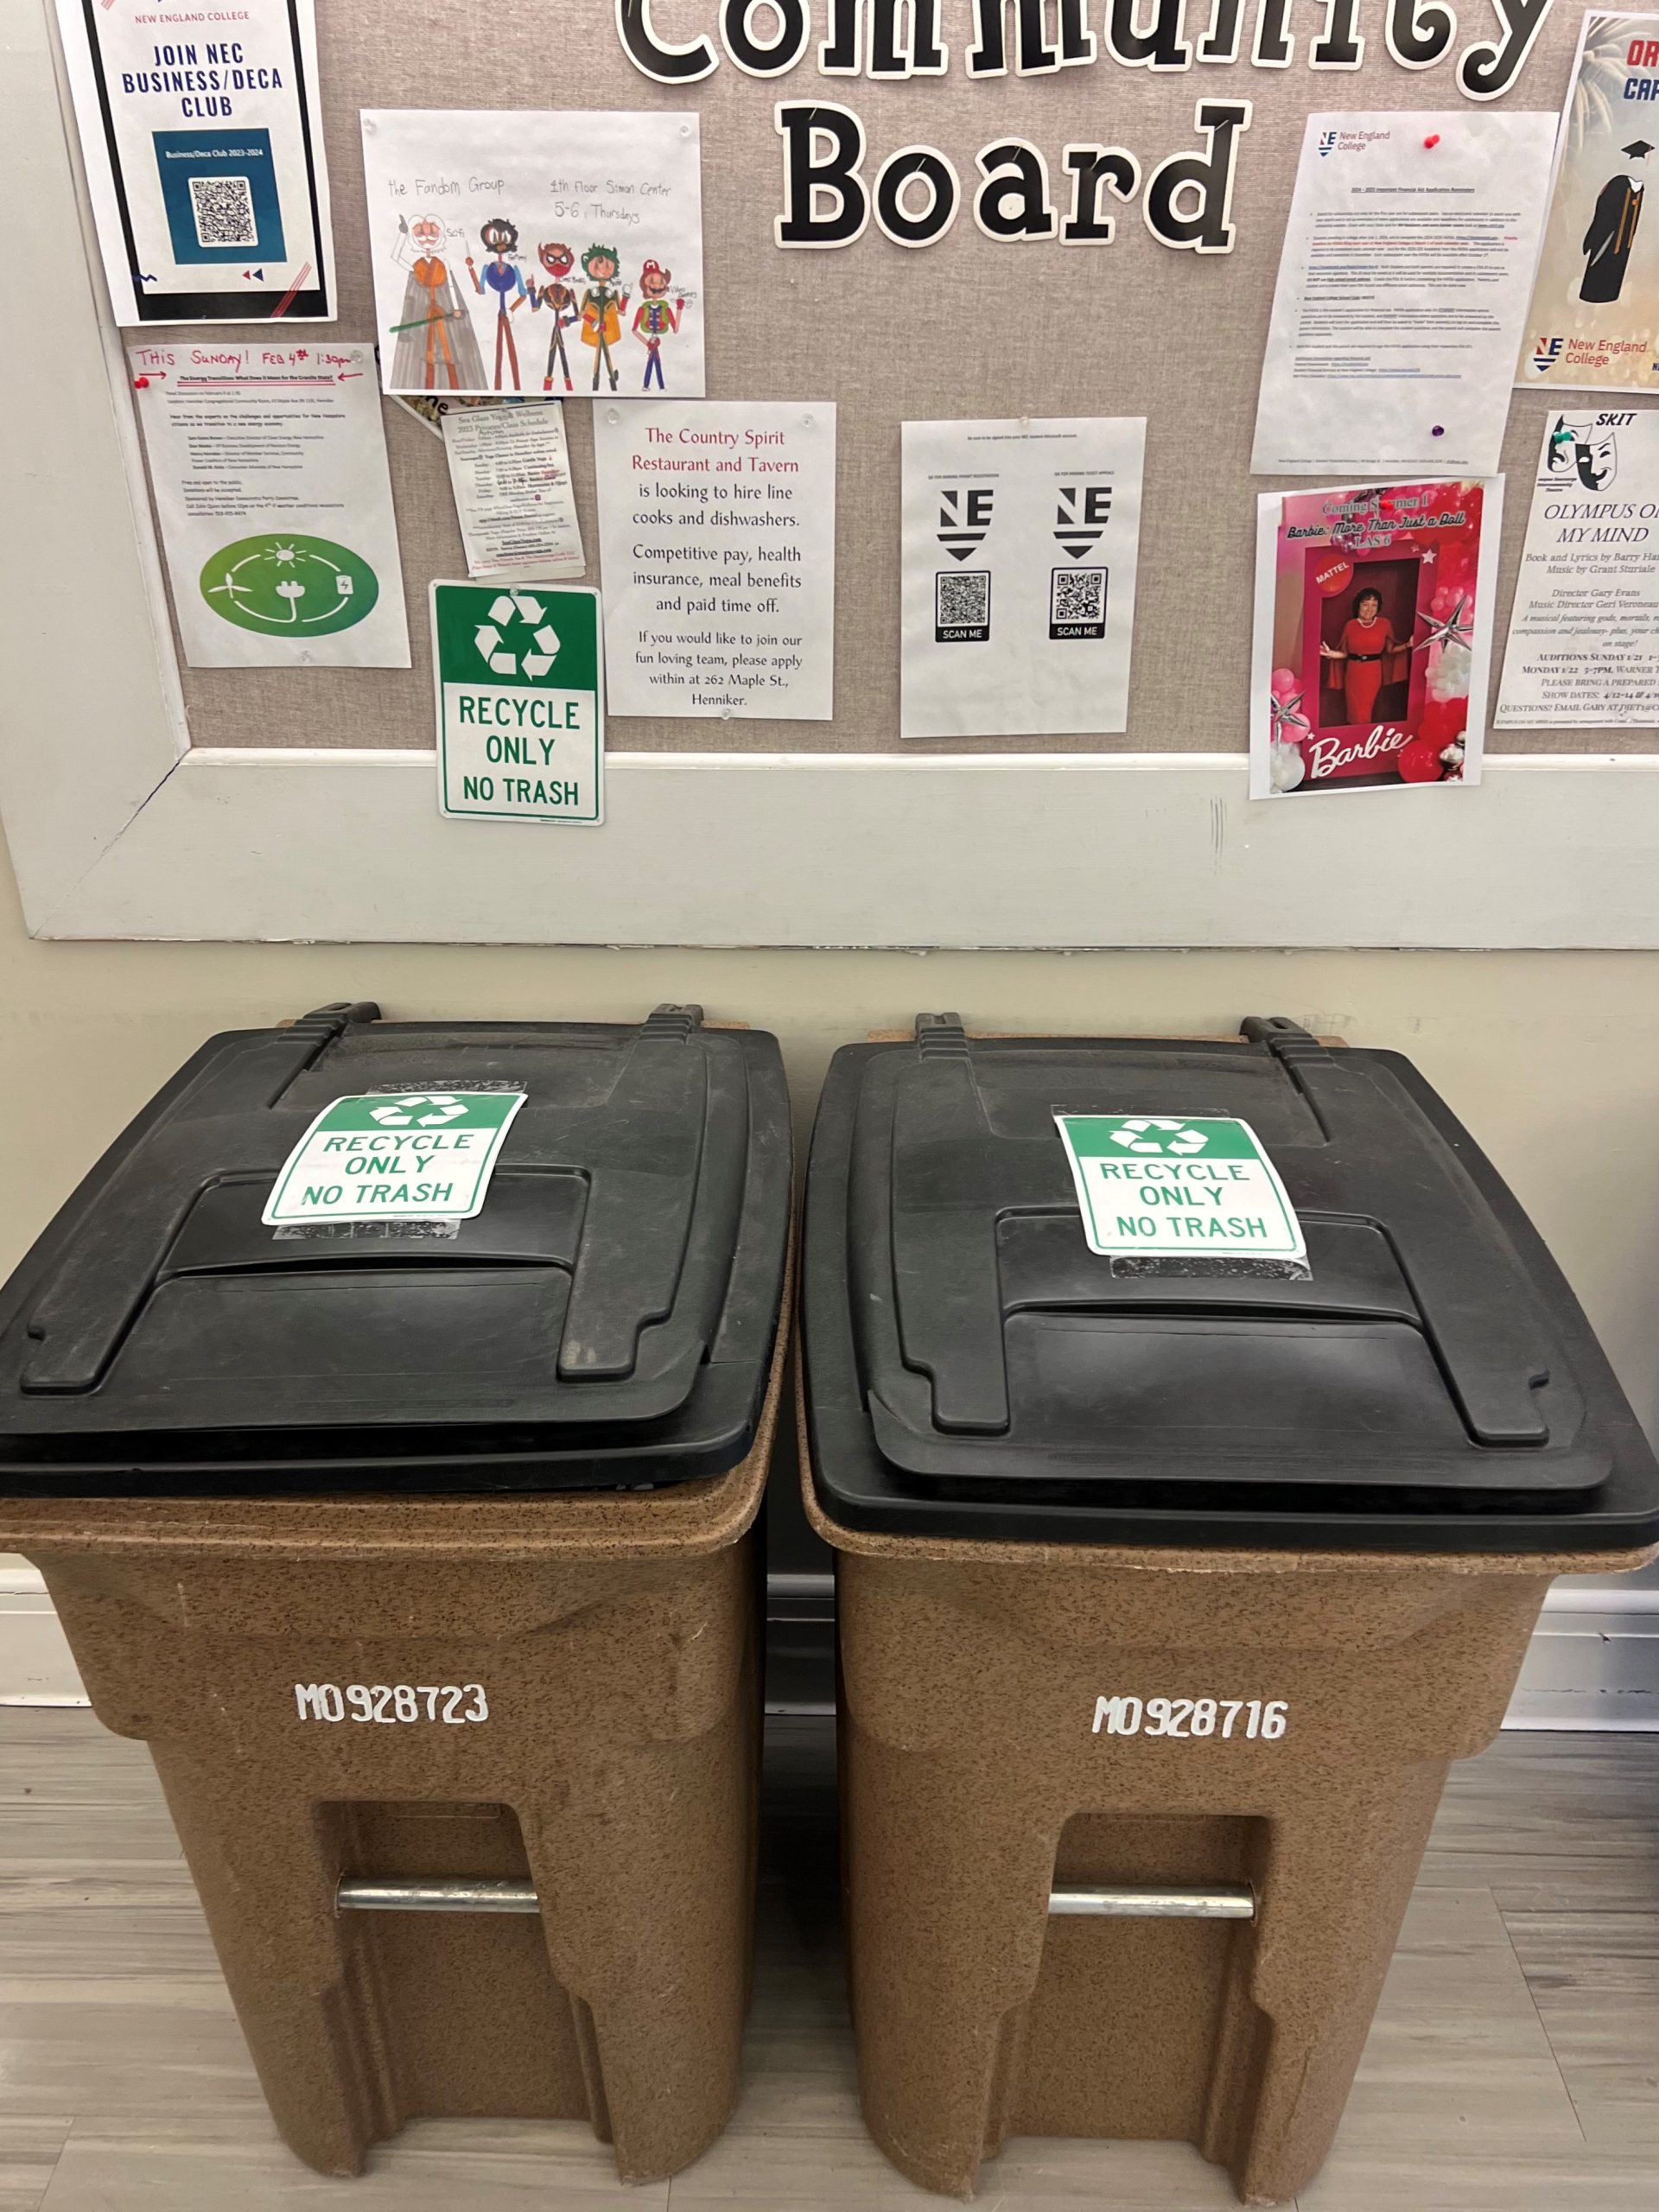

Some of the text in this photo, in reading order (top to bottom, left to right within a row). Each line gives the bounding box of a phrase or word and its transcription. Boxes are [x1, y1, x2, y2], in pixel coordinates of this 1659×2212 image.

[135, 11, 249, 24] NEW ENGLAND COLLEGE
[154, 43, 244, 66] JOIN NEC
[1626, 40, 1659, 67] OR
[122, 68, 283, 93] BUSINESS/DECA
[181, 97, 232, 118] CLUB
[1358, 131, 1390, 141] England
[213, 149, 227, 157] Club
[228, 148, 263, 157] 2023-2024
[1338, 143, 1366, 151] College
[779, 105, 1247, 249] Board
[389, 177, 505, 196] the Fandom Group
[606, 180, 634, 195] Simon
[639, 182, 672, 197] Center
[591, 204, 639, 226] Thursdays
[1569, 339, 1595, 350] New
[1599, 340, 1647, 355] England
[263, 353, 284, 365] FEB
[1566, 353, 1609, 366] College
[1596, 413, 1637, 425] SKIT
[645, 429, 785, 448] The Country Spirit
[632, 456, 798, 472] Restaurant and Tavern
[639, 482, 792, 502] is looking to hire line
[1323, 501, 1367, 515] Coming
[1545, 504, 1637, 518] OLYMPUS
[632, 511, 799, 526] cooks and dishwashers.
[1287, 512, 1465, 538] Barbie: More Than Just a Doll
[1355, 535, 1391, 548] LAS 6
[1556, 528, 1649, 543] MY MIND
[632, 544, 801, 565] Competitive pay, health
[1571, 553, 1598, 563] Lyrics
[1601, 553, 1611, 563] by
[1614, 553, 1640, 562] Barry
[1316, 562, 1349, 584] MATTEL
[1576, 566, 1587, 575] by
[633, 572, 801, 588] insurance, meal benefits
[1591, 589, 1613, 598] Gary
[657, 598, 779, 614] and paid time off.
[943, 629, 982, 639] SCAN ME
[1057, 626, 1097, 636] SCAN ME
[639, 632, 802, 647] If you would like to join our
[636, 653, 802, 670] fun loving team, please apply
[650, 674, 788, 688] within at 262 Maple St.,
[692, 694, 747, 706] Henniker.
[459, 696, 580, 729] RECYCLE
[1500, 704, 1552, 713] QUESTIONS?
[486, 735, 555, 766] ONLY
[1309, 726, 1413, 779] Barbie
[463, 776, 578, 805] NO TRASH
[323, 1135, 474, 1152] RECYCLE
[346, 1155, 436, 1175] ONLY
[1100, 1163, 1250, 1180] RECYCLE
[302, 1182, 454, 1205] NO TRASH
[1139, 1186, 1224, 1205] ONLY
[1116, 1217, 1268, 1237] NO TRASH
